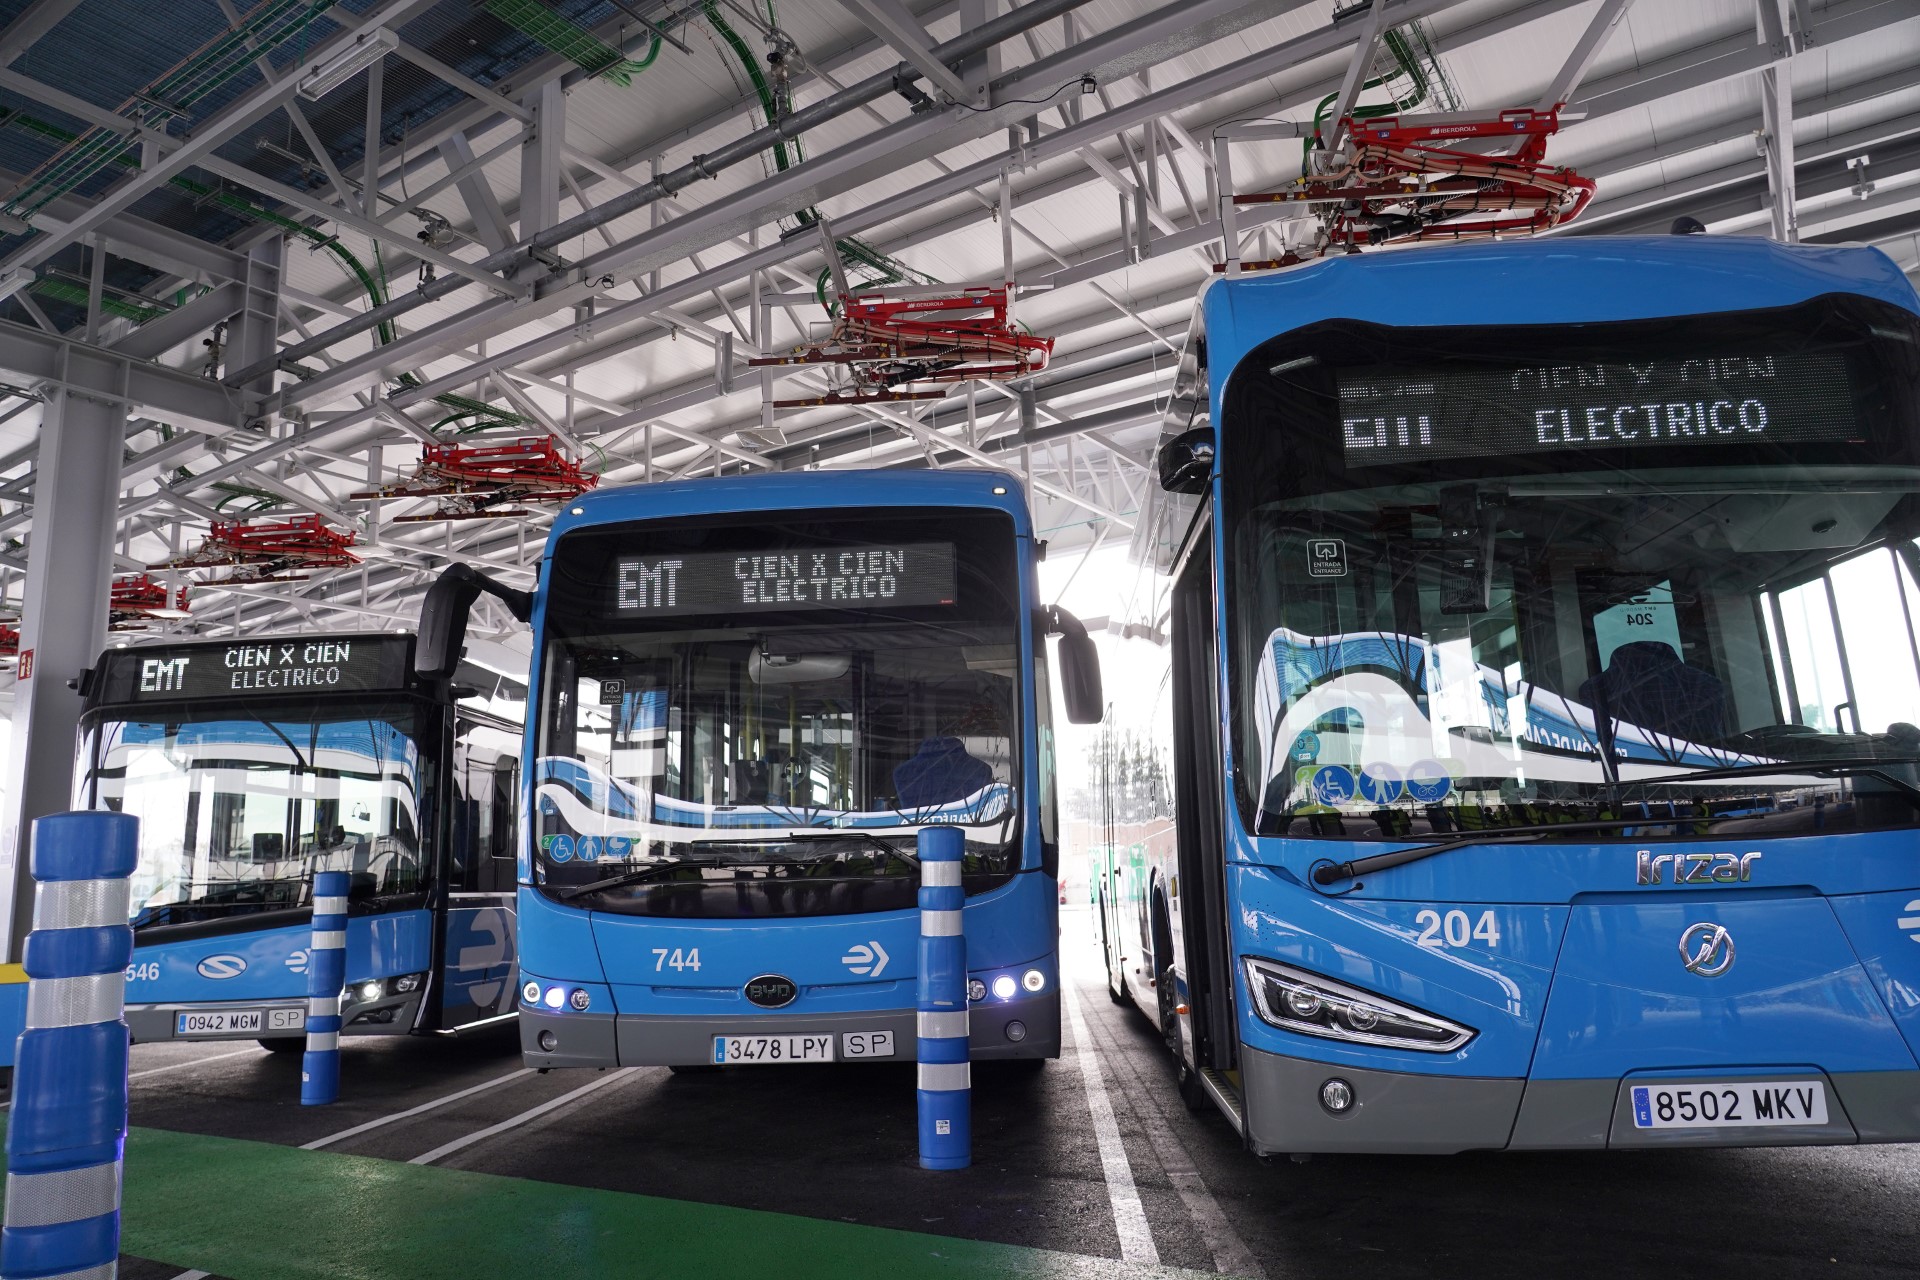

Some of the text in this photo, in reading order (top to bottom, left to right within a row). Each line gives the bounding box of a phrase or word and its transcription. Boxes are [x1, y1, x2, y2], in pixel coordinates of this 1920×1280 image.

[1440, 126, 1477, 134] IBERDROLA
[1534, 399, 1769, 444] ELECTRICO
[735, 550, 904, 579] CIEN X CIEN
[618, 560, 683, 609] EMT
[743, 575, 896, 604] ELECTRICO
[224, 644, 350, 668] CIEN X CIEN
[140, 658, 190, 692] EMT
[231, 666, 341, 690] ELECTRICO
[1636, 850, 1762, 885] Irizar
[1415, 909, 1500, 947] 204
[125, 962, 160, 982] 546
[651, 948, 702, 972] 744
[749, 984, 791, 999] BYD
[188, 1014, 259, 1030] 0942 MGM
[274, 1011, 299, 1027] SP
[730, 1039, 782, 1060] 3478
[789, 1037, 828, 1059] LPY
[850, 1034, 887, 1054] SP
[1656, 1090, 1742, 1122] 8502
[1752, 1087, 1814, 1120] MKV
